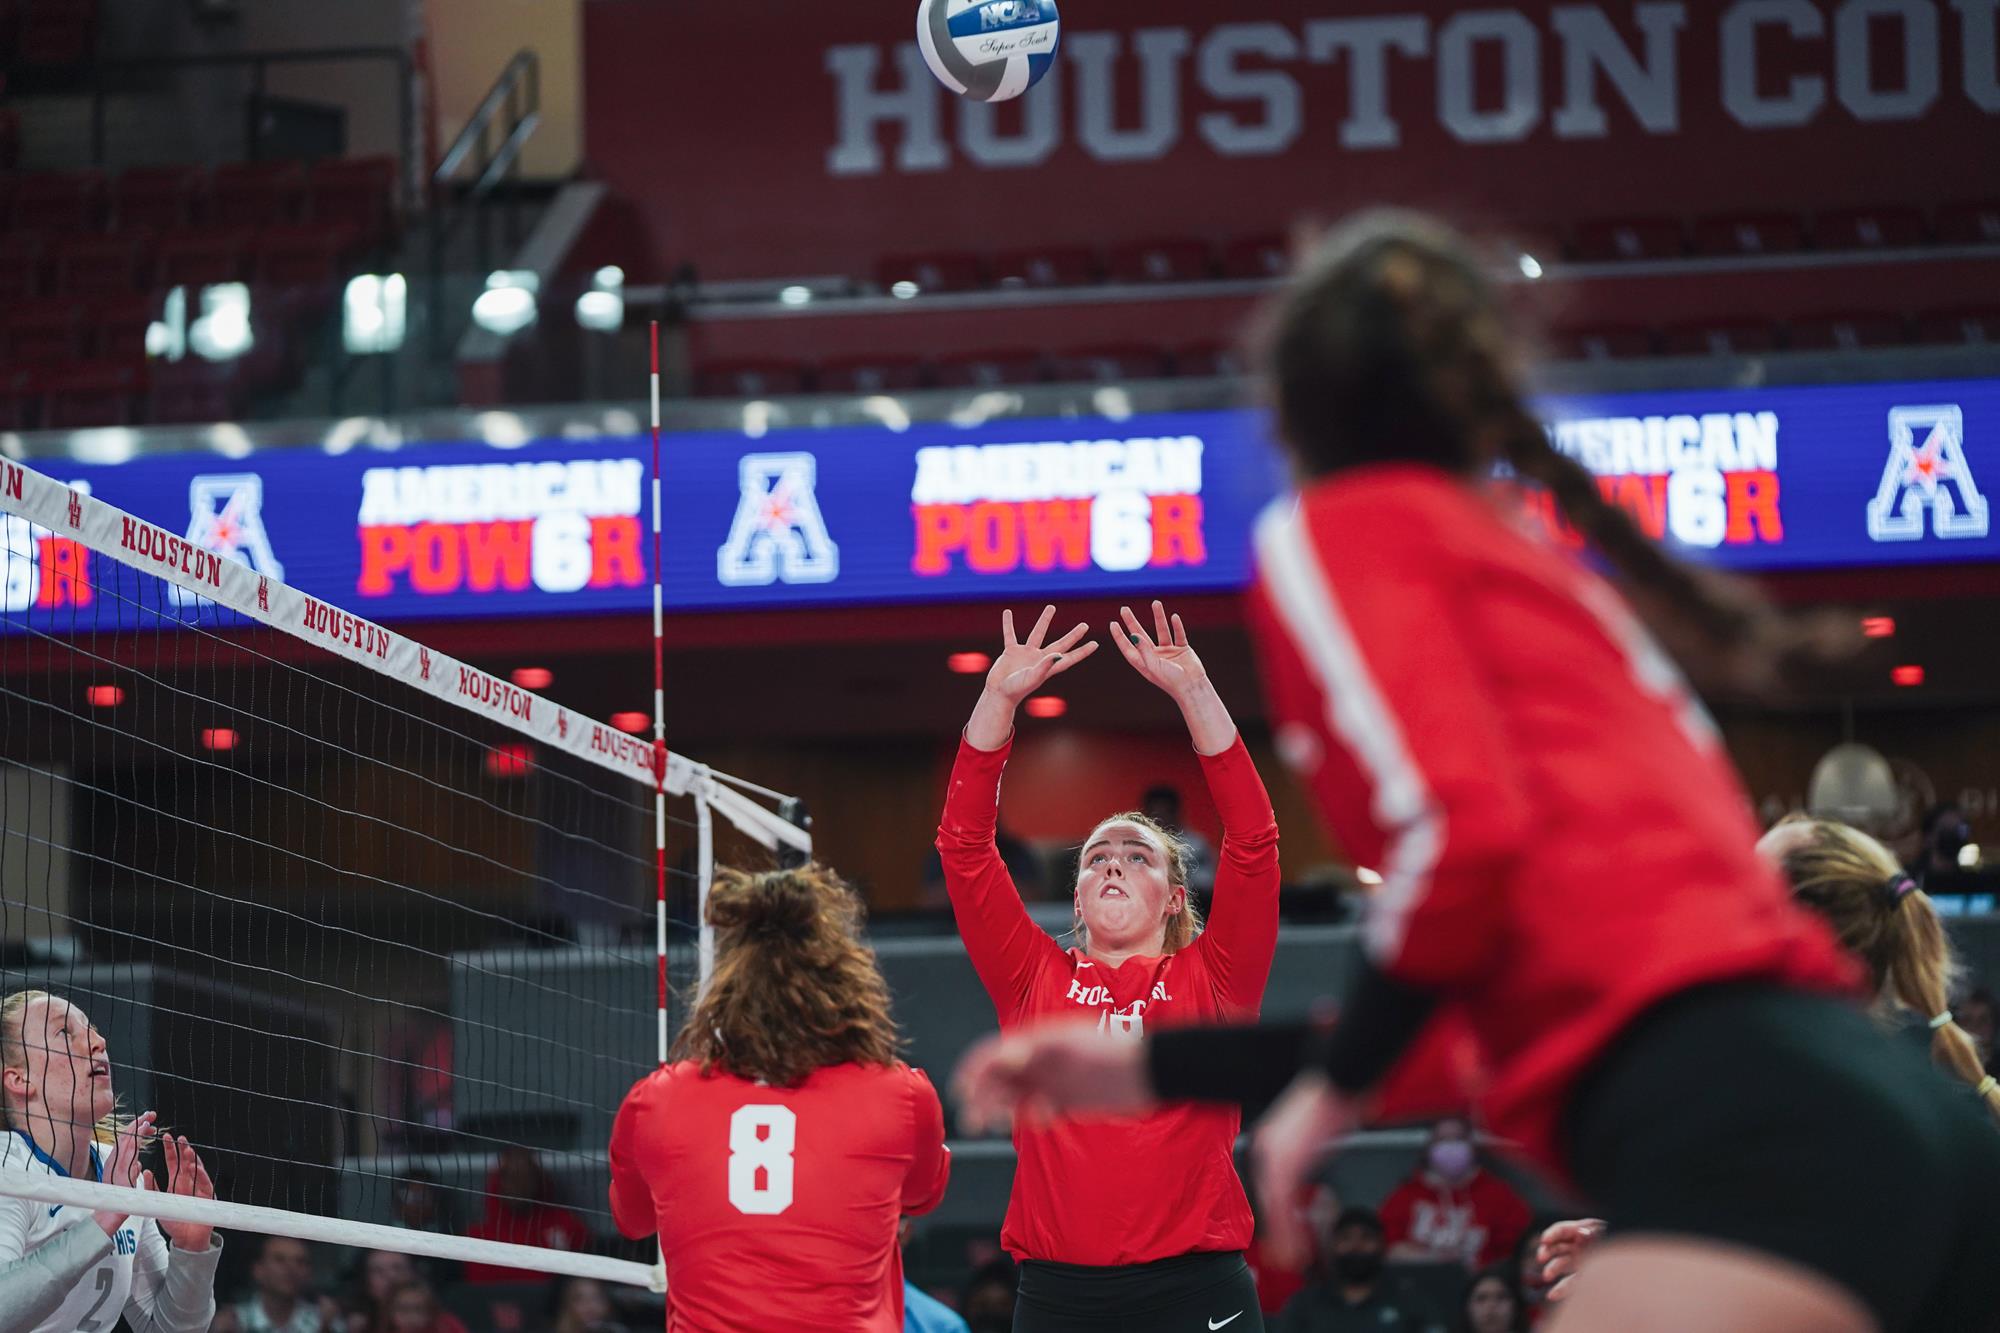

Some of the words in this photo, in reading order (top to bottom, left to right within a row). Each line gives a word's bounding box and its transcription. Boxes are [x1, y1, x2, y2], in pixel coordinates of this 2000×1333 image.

[979, 38, 1016, 55] Super
[358, 458, 644, 526] AMERICAN
[911, 435, 1204, 505] AMERICAN
[358, 510, 646, 596] POW6R
[911, 490, 1207, 576] POW6R
[120, 515, 222, 587] HOUSTON
[303, 597, 390, 660] HOUSTON
[459, 666, 533, 721] HOUSTON
[728, 1104, 797, 1216] 8
